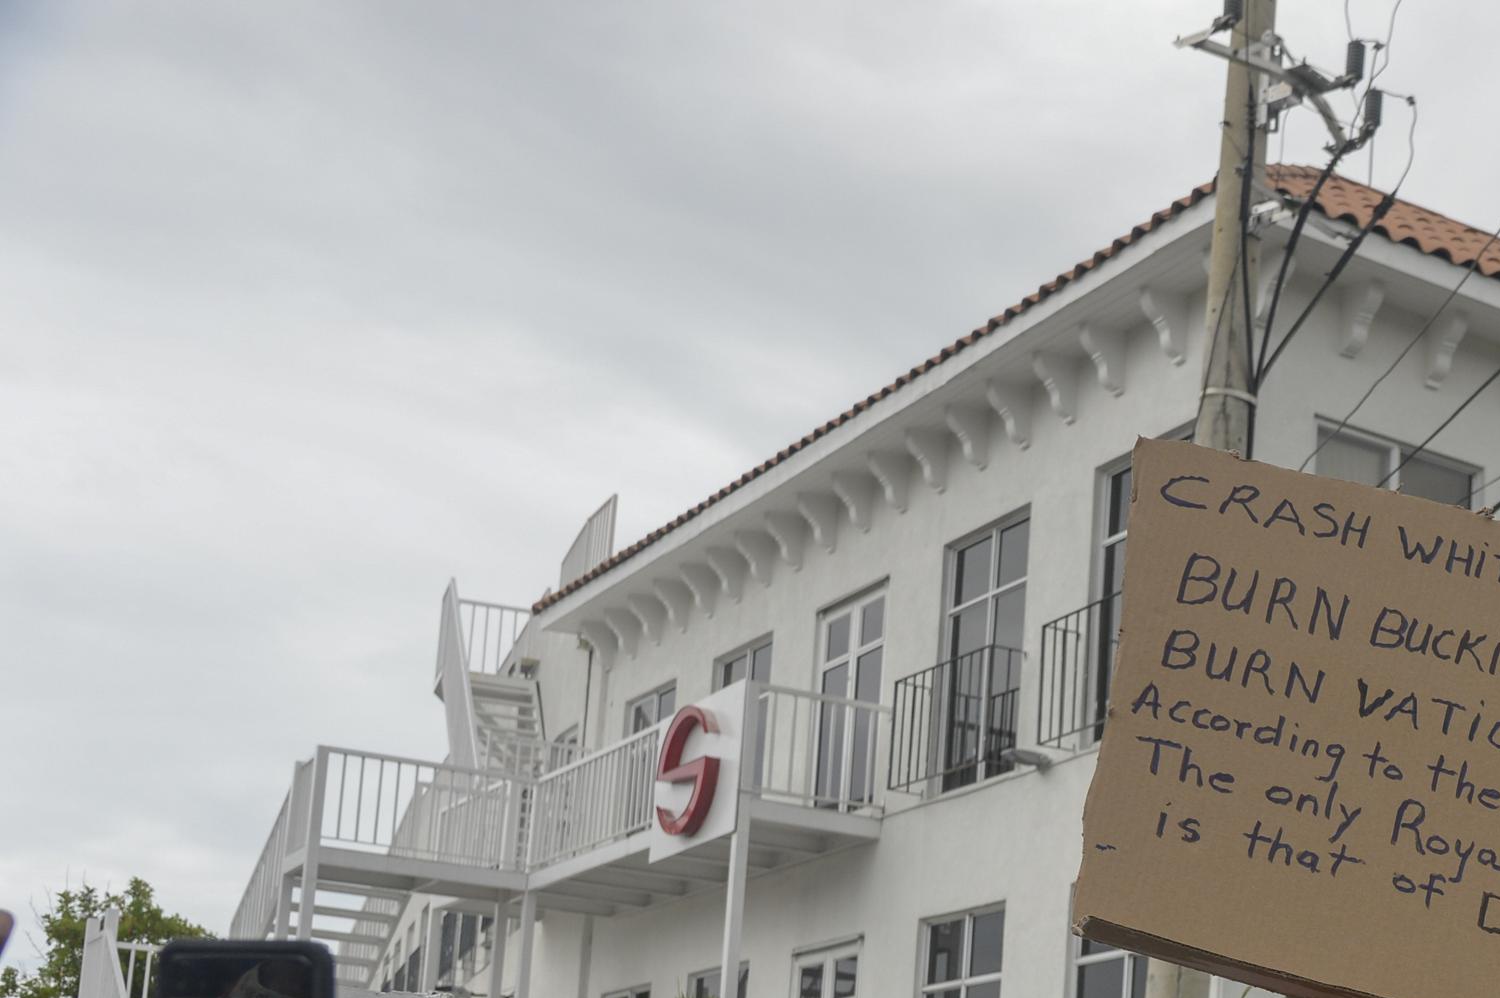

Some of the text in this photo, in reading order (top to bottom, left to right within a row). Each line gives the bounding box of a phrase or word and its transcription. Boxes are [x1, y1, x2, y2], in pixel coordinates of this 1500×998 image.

[1160, 476, 1371, 548] CRASH
[1176, 553, 1350, 640] BURN
[1161, 630, 1326, 703] BURN
[1131, 681, 1346, 782] According
[1362, 741, 1404, 779] to
[1136, 736, 1235, 793] The
[1265, 781, 1362, 844] only
[1156, 802, 1201, 843] is
[1243, 821, 1366, 877] that
[1392, 871, 1447, 910] of
